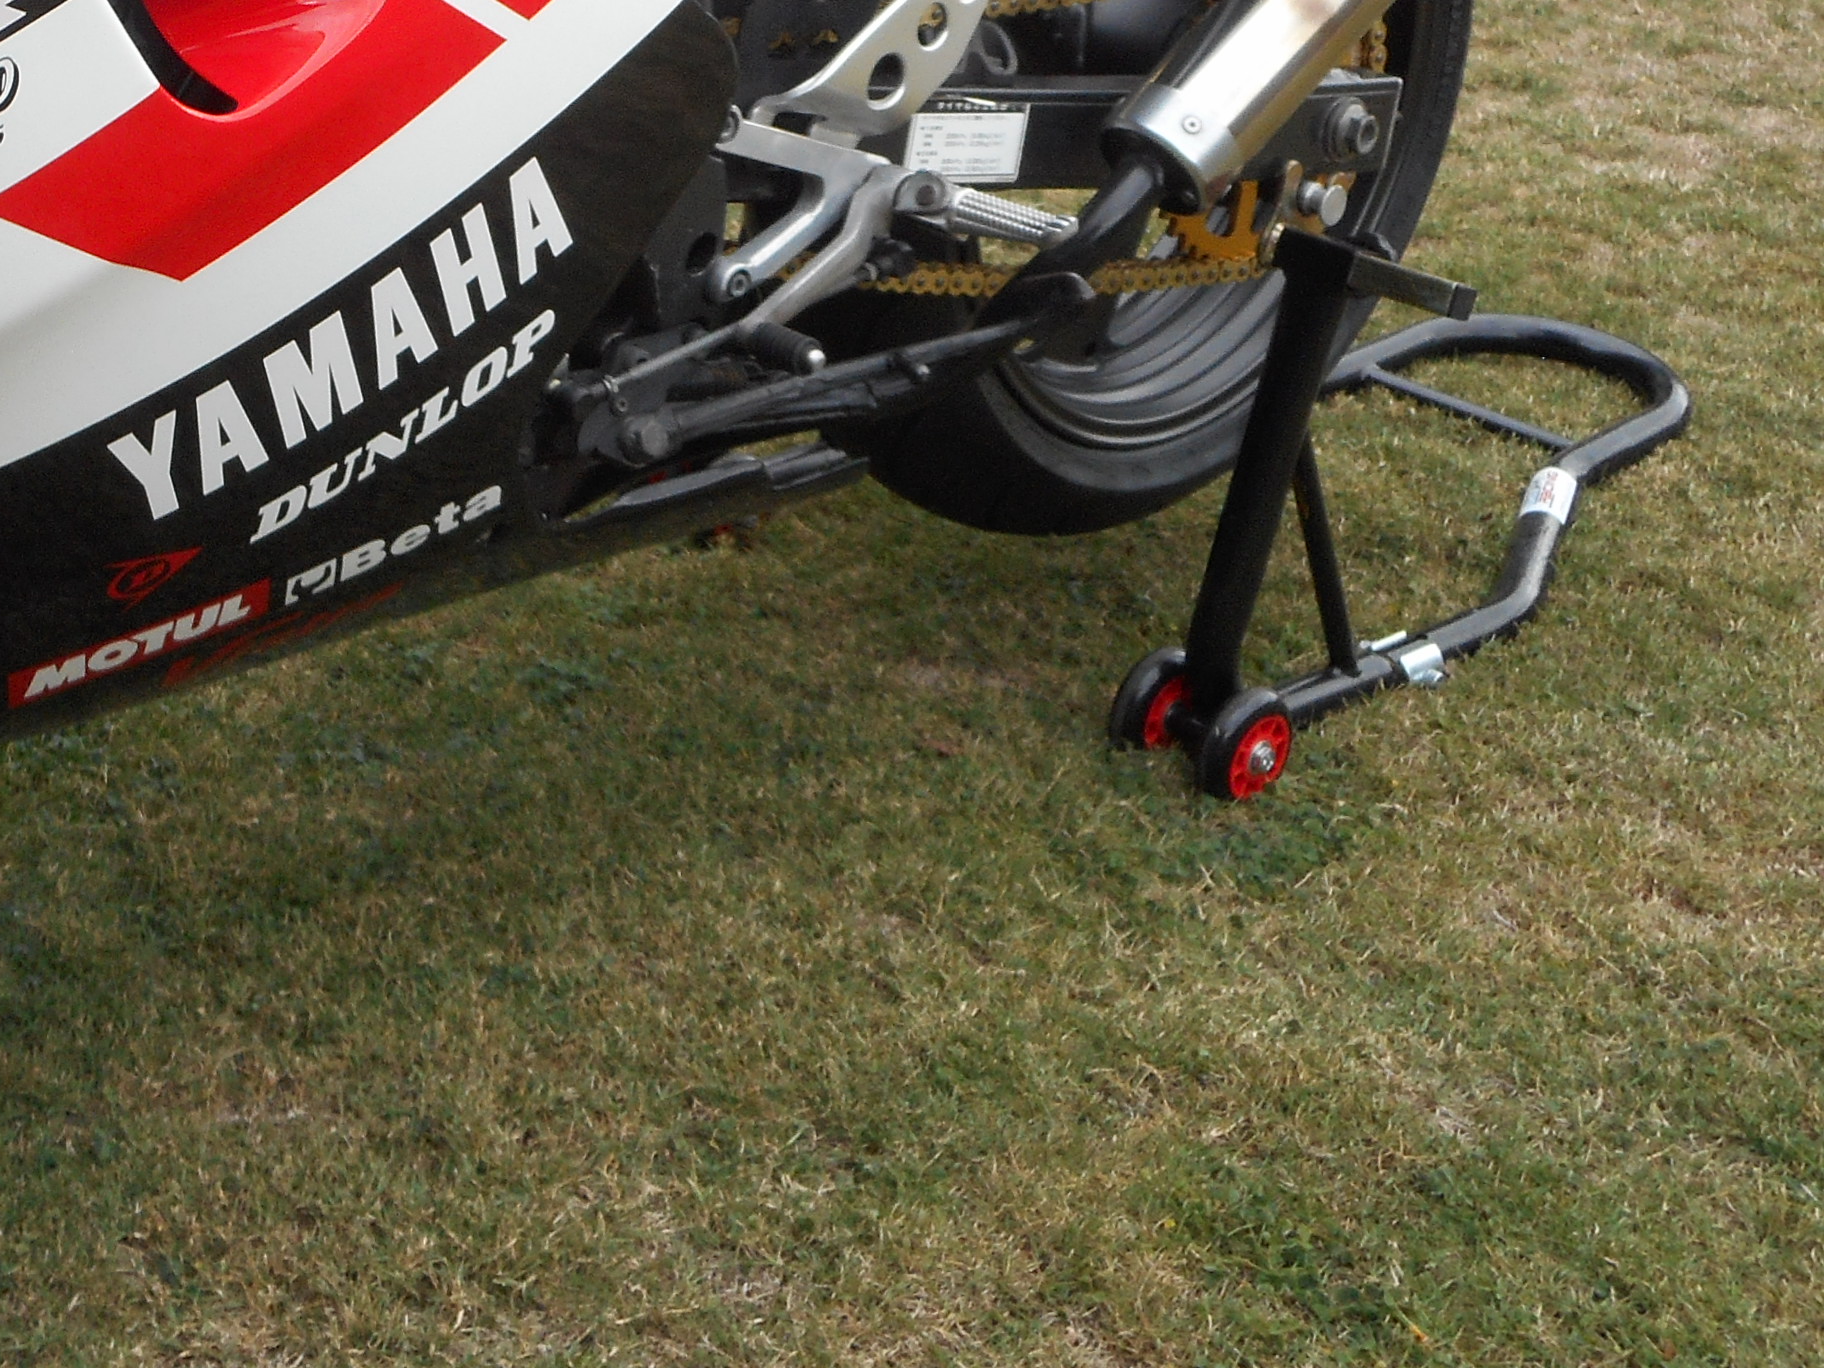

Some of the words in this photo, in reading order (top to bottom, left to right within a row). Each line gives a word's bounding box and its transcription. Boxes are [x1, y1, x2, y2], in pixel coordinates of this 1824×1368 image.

[106, 156, 573, 520] YAMAHA
[249, 309, 556, 545] DUNLOP
[340, 485, 503, 581] Beta
[23, 592, 253, 699] MOTUL
